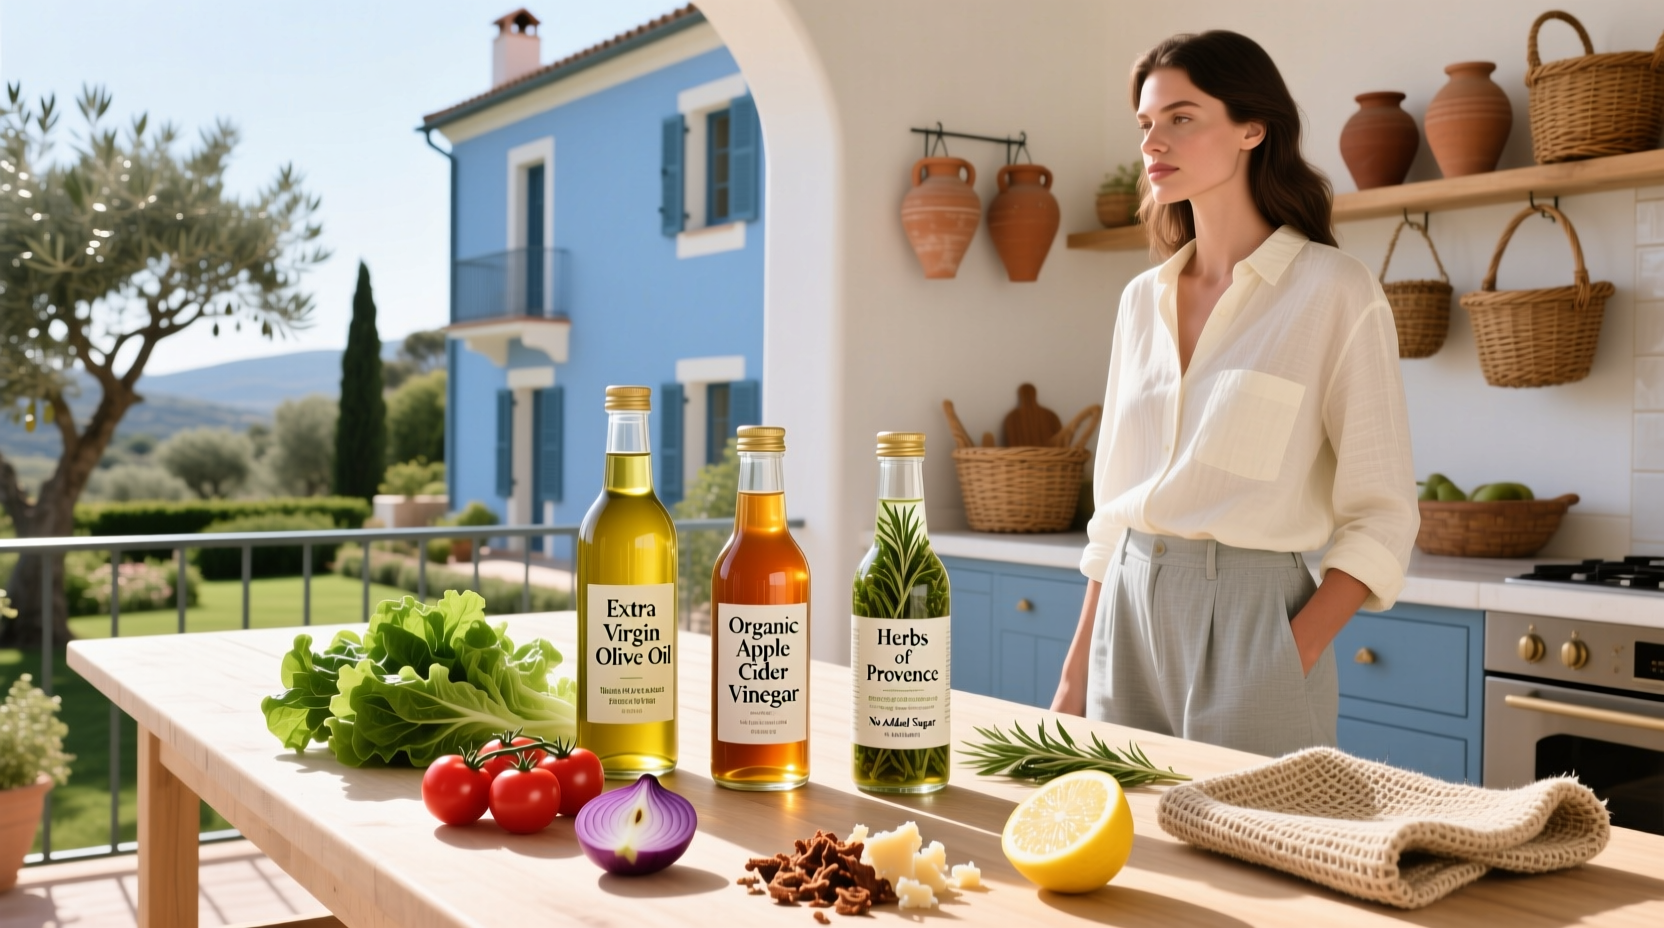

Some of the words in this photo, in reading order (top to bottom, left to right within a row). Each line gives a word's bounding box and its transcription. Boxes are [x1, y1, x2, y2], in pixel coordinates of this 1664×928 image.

[607, 599, 656, 618] Extra
[603, 624, 660, 647] Virgin
[729, 616, 799, 640] Organic
[878, 628, 929, 646] Herbs
[596, 647, 644, 666] Olive
[648, 645, 671, 665] Oil
[736, 638, 790, 663] Apple
[895, 649, 913, 664] of
[739, 661, 789, 680] Cider
[867, 664, 939, 682] Provence
[729, 685, 800, 708] Vinegar
